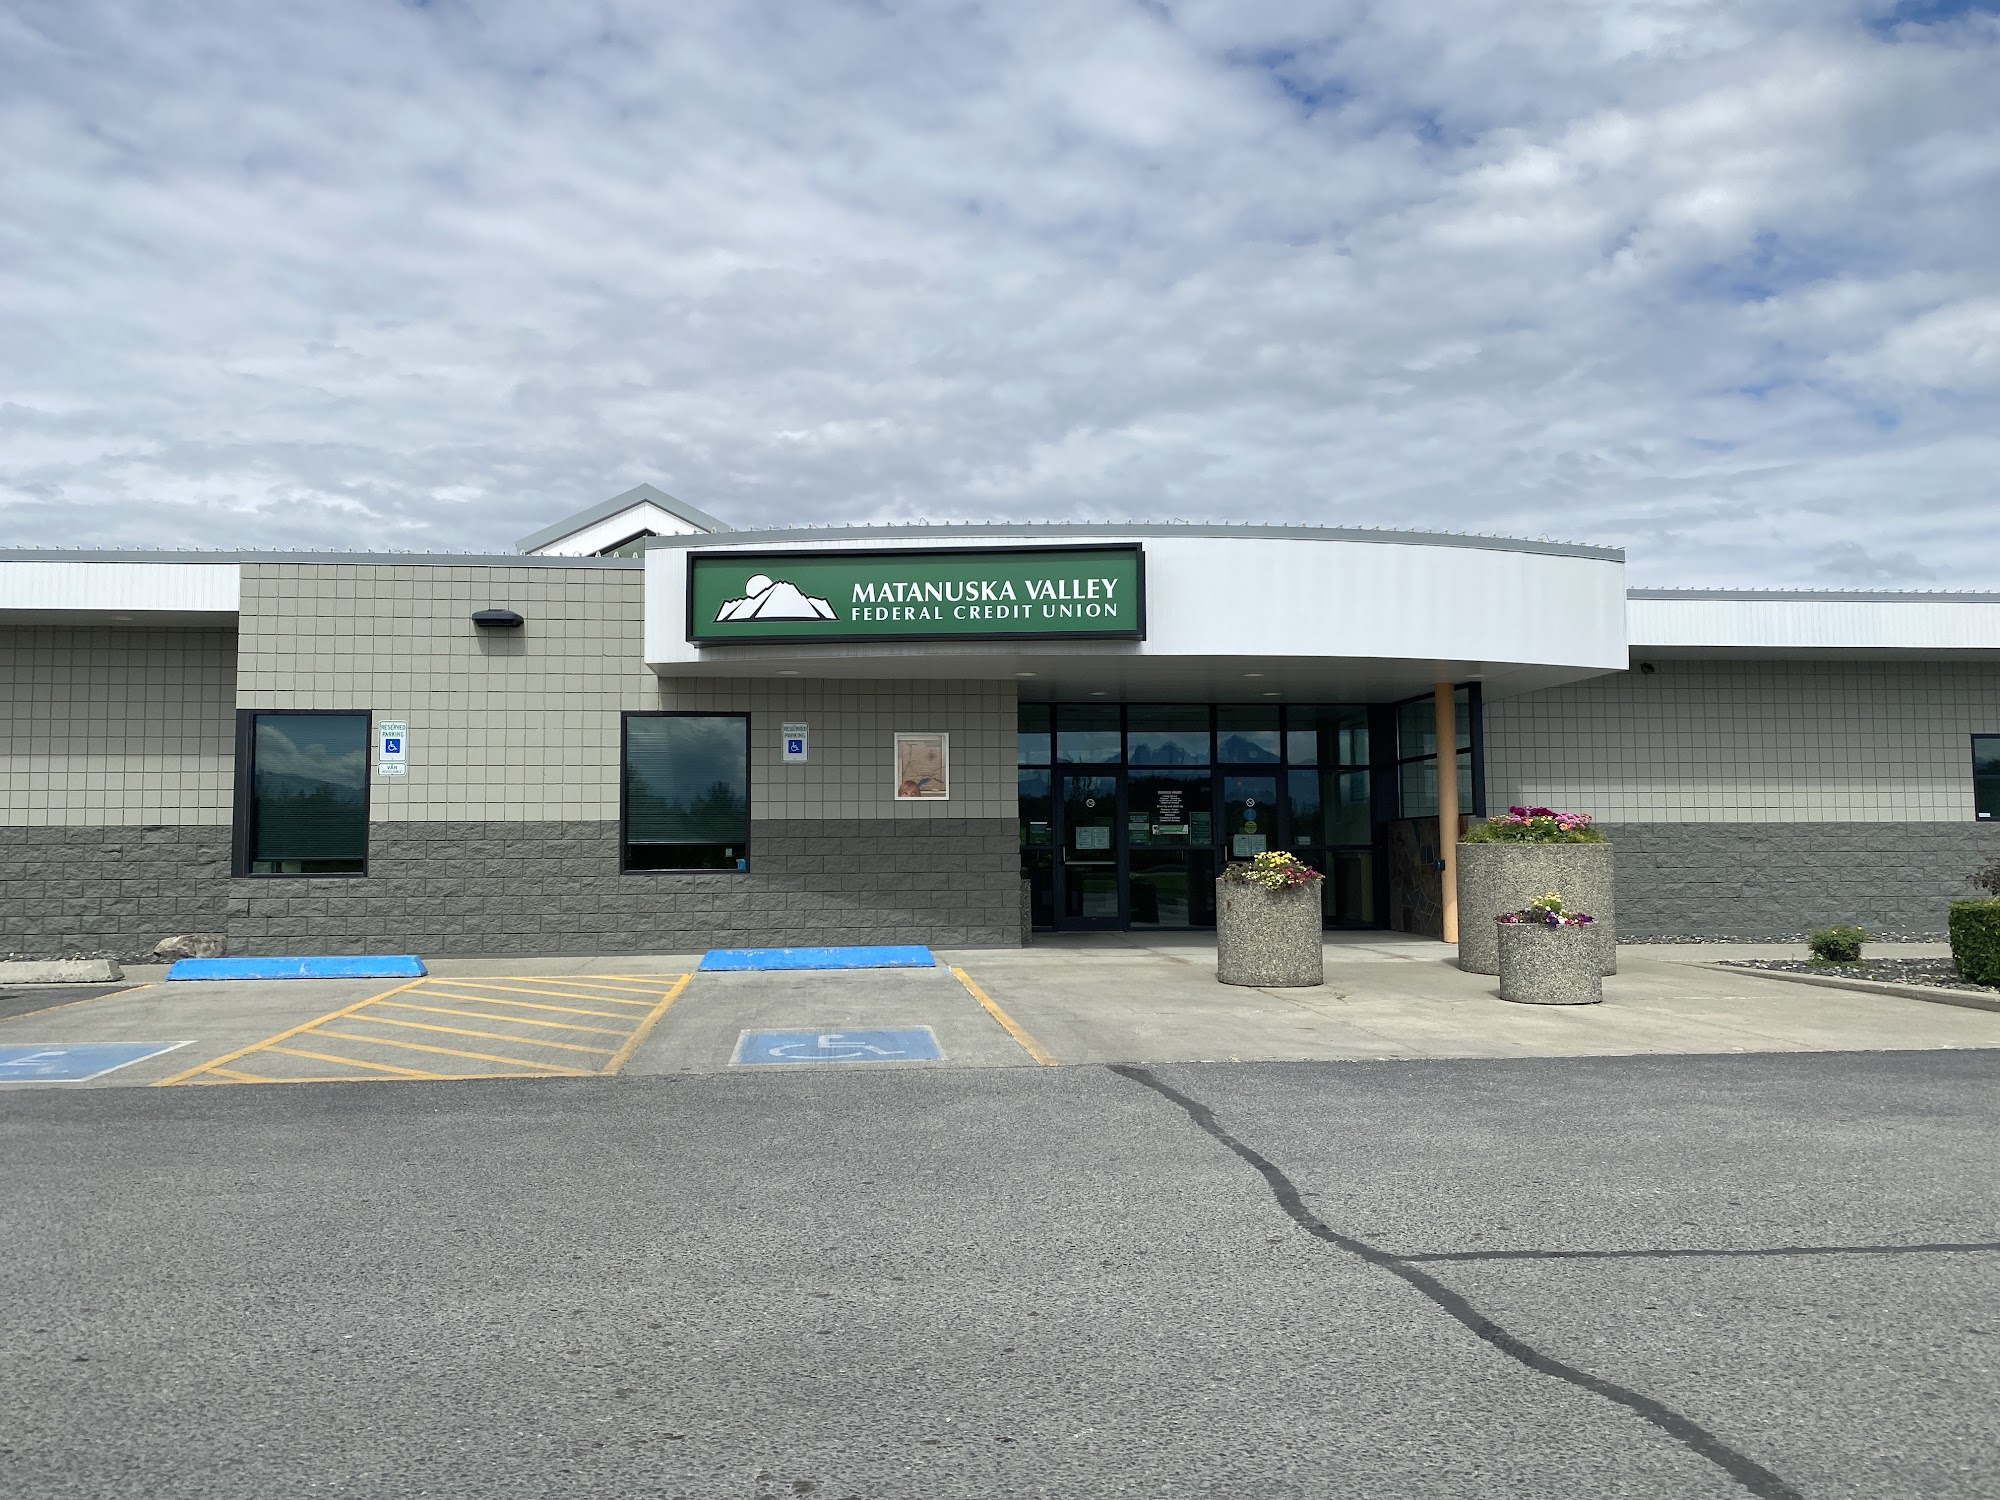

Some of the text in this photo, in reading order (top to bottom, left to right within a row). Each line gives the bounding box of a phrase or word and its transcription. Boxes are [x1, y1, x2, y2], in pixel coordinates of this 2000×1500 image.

[852, 578, 1118, 603] MATANUSKA VALLEY
[852, 603, 1117, 621] FEDERAL CREDIT UNION
